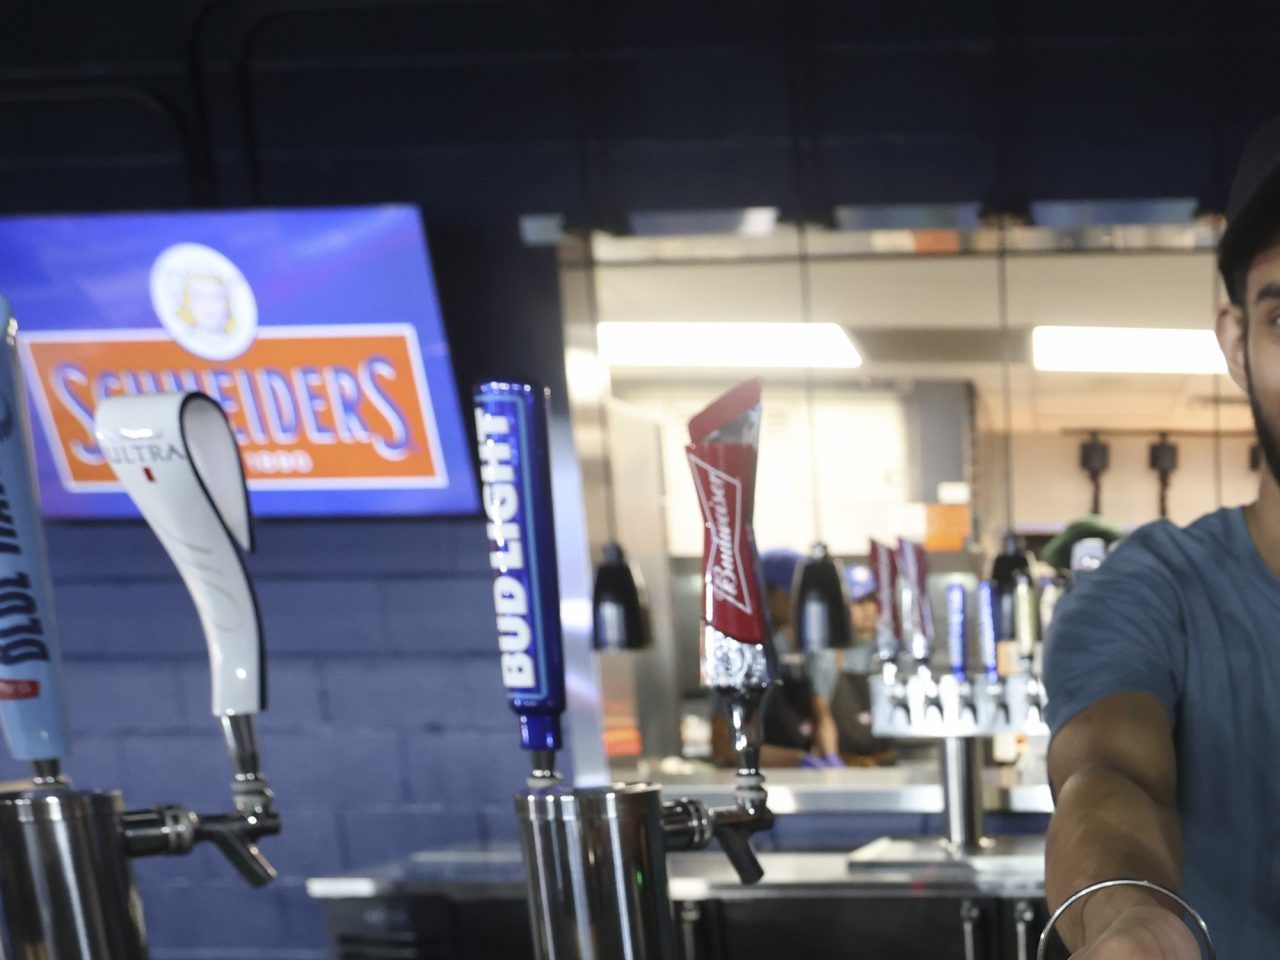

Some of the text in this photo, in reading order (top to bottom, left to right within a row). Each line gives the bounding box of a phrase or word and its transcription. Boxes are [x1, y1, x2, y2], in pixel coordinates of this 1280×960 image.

[50, 355, 411, 461] SEIDERS
[107, 444, 187, 465] ULTRA
[474, 407, 536, 688] BUD LIGHT
[708, 468, 739, 602] Budweiser
